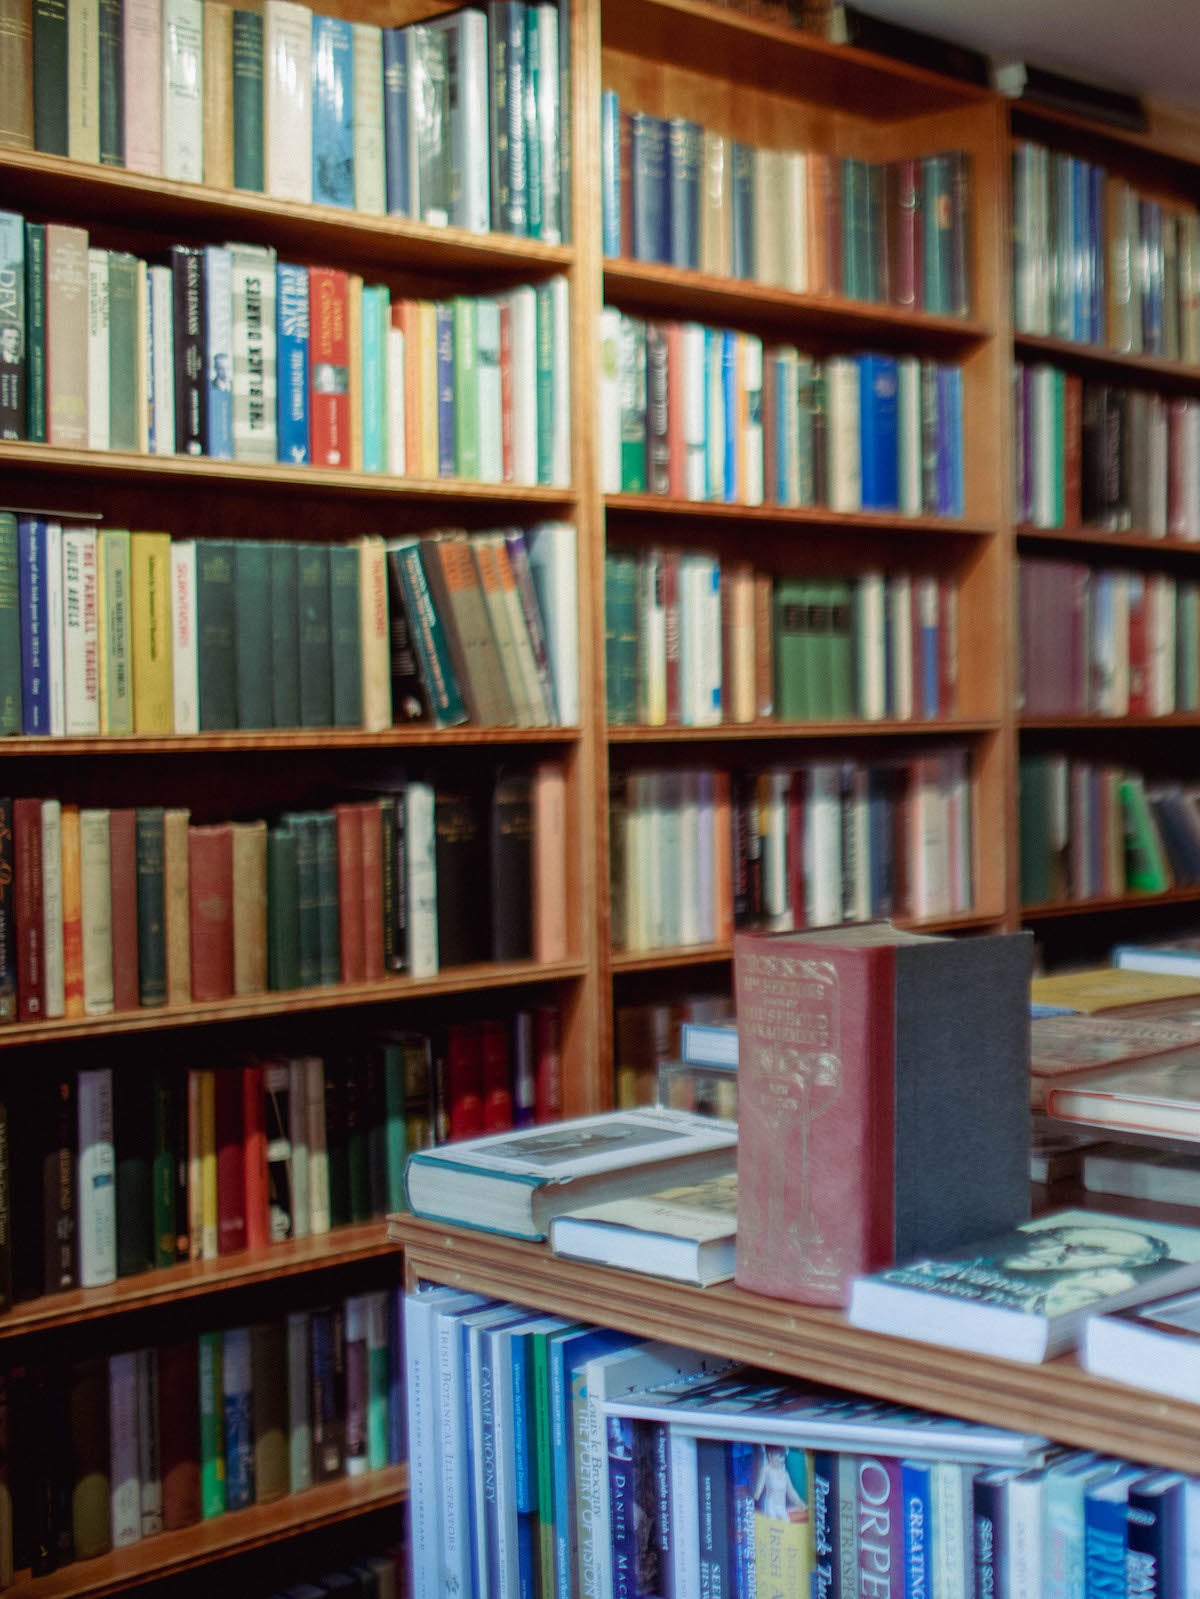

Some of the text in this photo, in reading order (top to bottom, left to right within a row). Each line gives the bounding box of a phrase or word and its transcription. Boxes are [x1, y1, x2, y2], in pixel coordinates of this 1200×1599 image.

[244, 277, 265, 430] THE BLACK DIARIES
[66, 541, 81, 629] JULES ABELS
[84, 543, 97, 703] THE PARNELL TRAGEDY
[415, 1360, 423, 1448] REPRESENTING
[514, 1395, 523, 1415] Scott
[440, 1328, 457, 1553] IRISH BOTANICAL ILLUSTRATORS
[483, 1366, 496, 1505] CARMEL MOONEY
[515, 1416, 524, 1453] Paintings
[588, 1393, 603, 1518] Louis le Brocquy
[659, 1437, 667, 1469] buyer's
[517, 1471, 525, 1510] Drawings
[578, 1407, 596, 1596] THE POETRY OF VISION
[615, 1474, 626, 1541] DANIEL
[659, 1471, 668, 1498] guide
[661, 1499, 668, 1511] to
[705, 1476, 713, 1500] LOUIS
[661, 1512, 670, 1533] irish
[661, 1534, 670, 1551] art
[705, 1512, 714, 1551] BROCQUY
[743, 1497, 757, 1560] stepping
[814, 1477, 833, 1557] Patrick
[701, 1561, 710, 1589] HIS
[769, 1526, 785, 1578] IRISH
